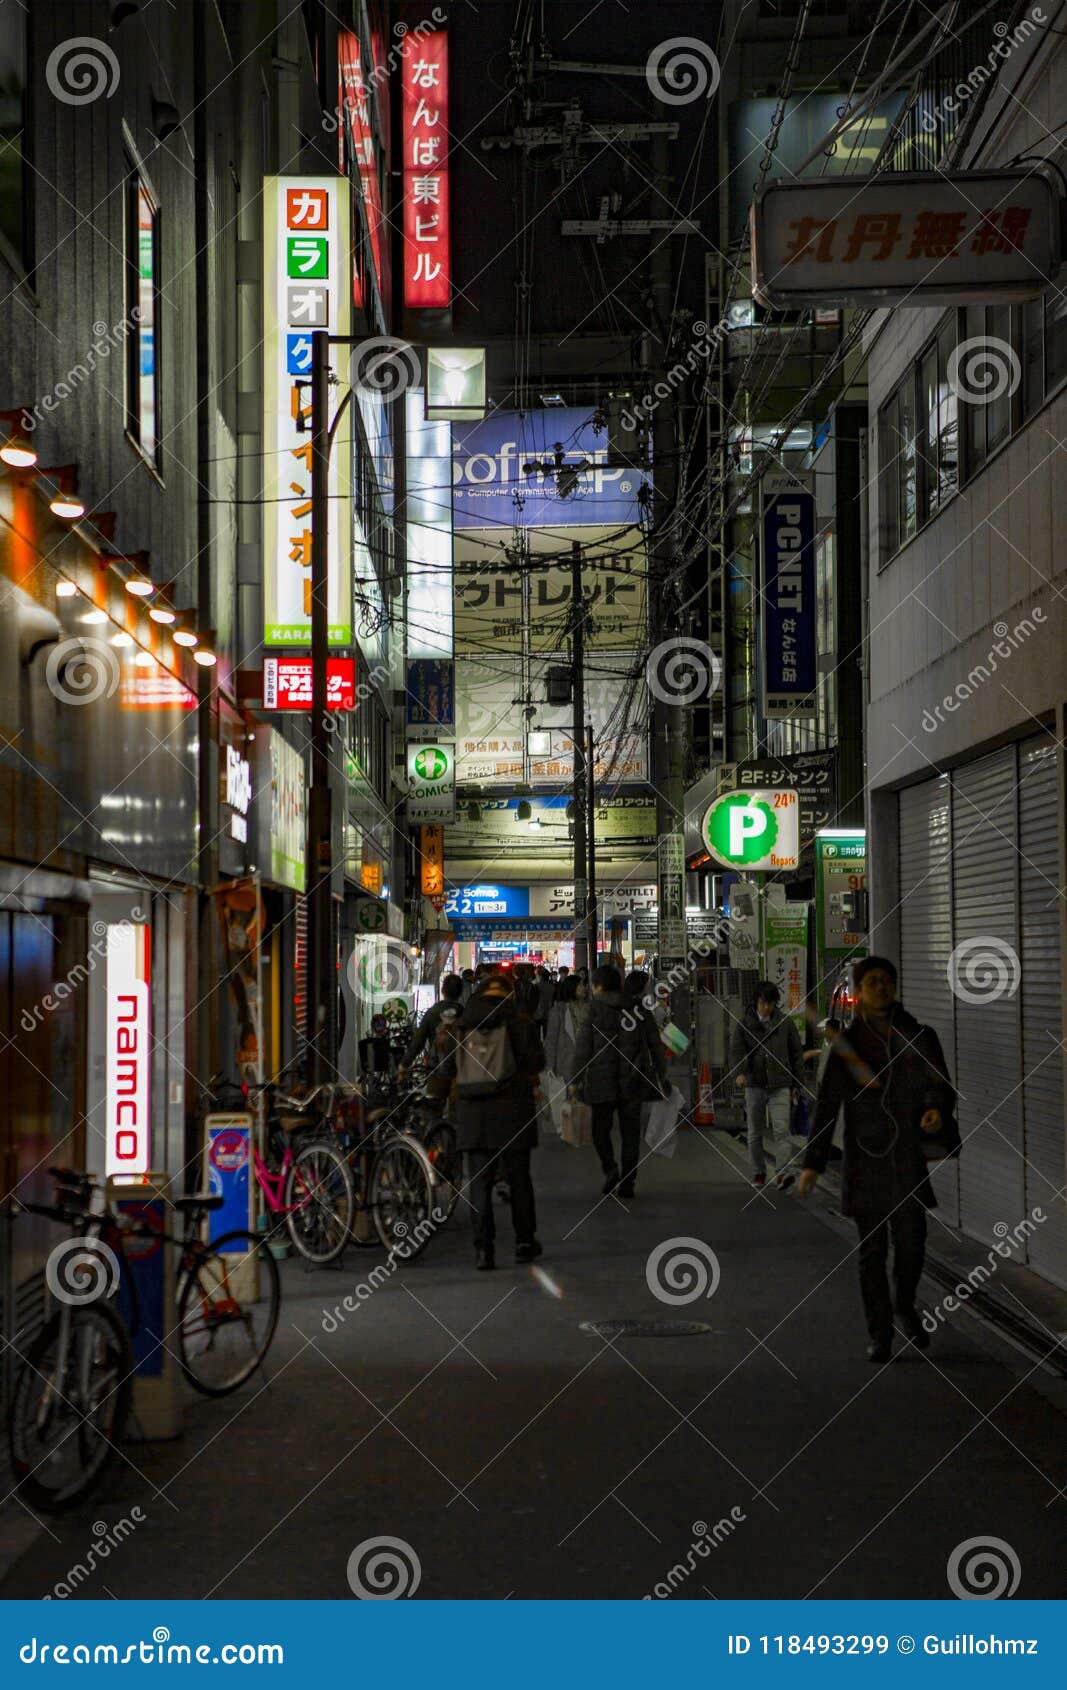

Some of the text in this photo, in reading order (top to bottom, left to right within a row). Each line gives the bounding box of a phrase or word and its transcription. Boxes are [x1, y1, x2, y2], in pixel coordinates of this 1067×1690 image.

[411, 59, 442, 282] なんば東ビル
[784, 207, 1032, 264] 丸丹無線
[468, 488, 508, 497] Computer
[776, 504, 802, 613] PCNET
[272, 630, 343, 641] KARAKE
[770, 854, 797, 866] Repark
[463, 888, 499, 899] Sofmap
[616, 888, 655, 897] OUTLET
[115, 995, 138, 1160] namco
